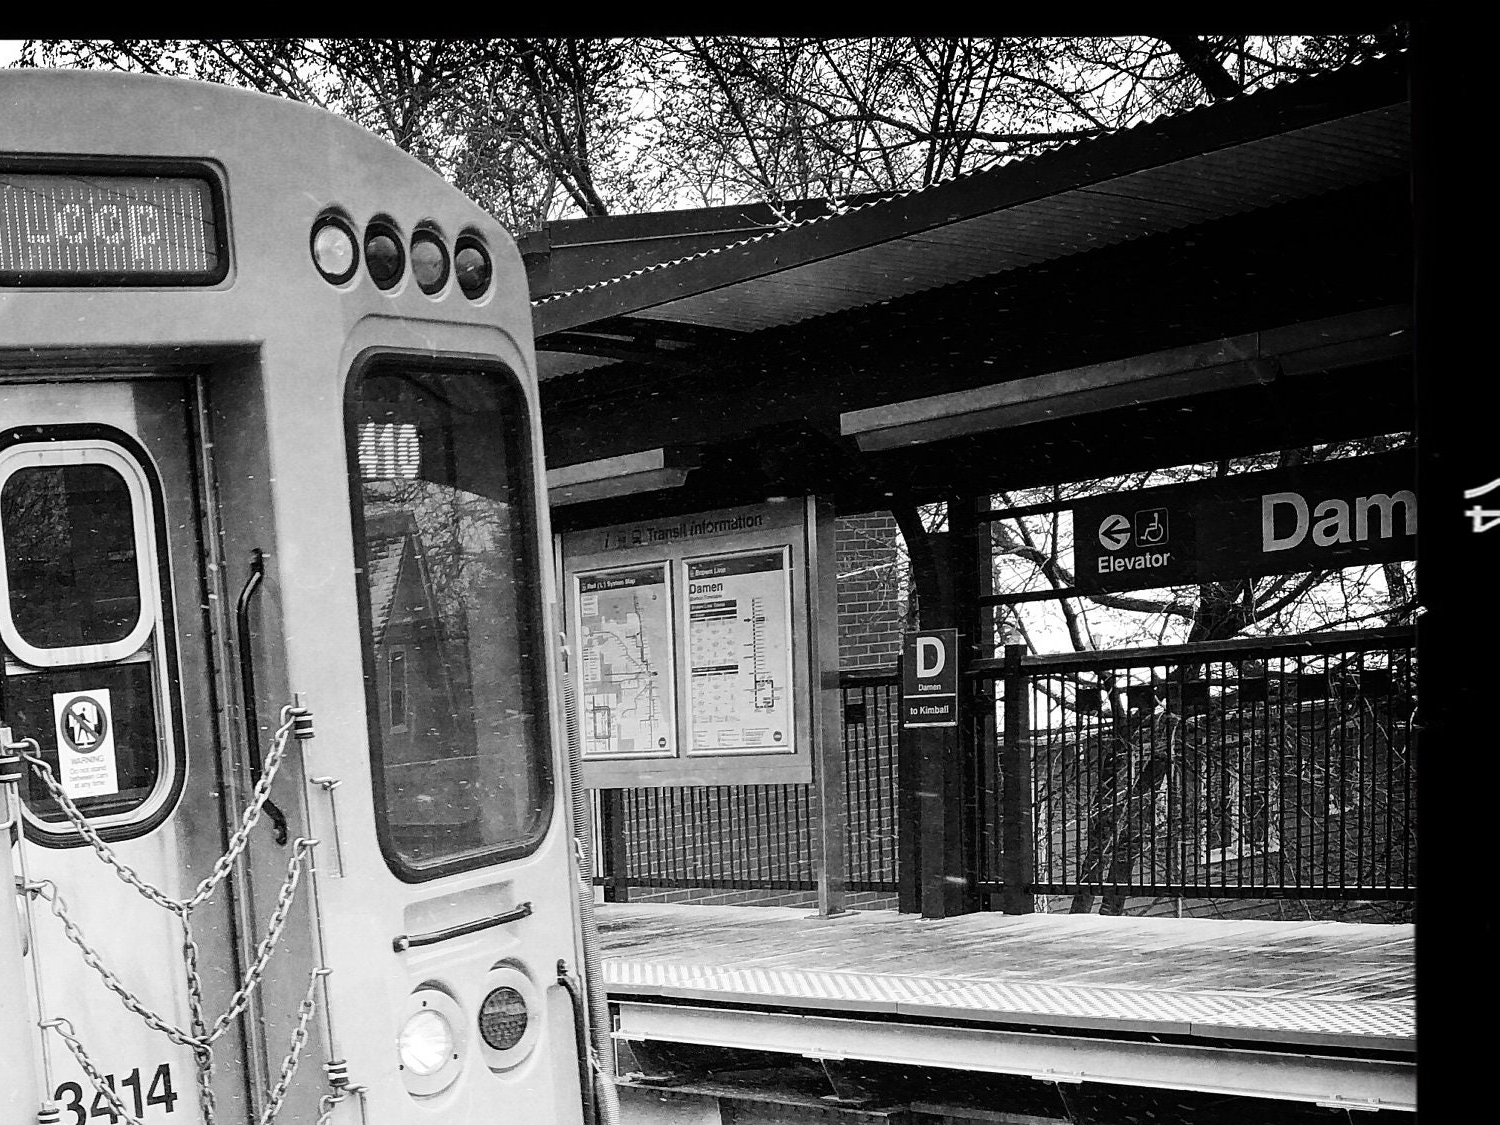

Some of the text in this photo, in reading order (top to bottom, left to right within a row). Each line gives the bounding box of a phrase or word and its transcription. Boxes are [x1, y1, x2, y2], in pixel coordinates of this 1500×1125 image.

[646, 514, 763, 542] Transit information
[1261, 489, 1419, 553] Dam
[1097, 551, 1171, 574] Elevator
[689, 583, 724, 595] Damen
[916, 636, 946, 678] D
[918, 683, 942, 692] Damen
[910, 705, 949, 715] to Kimball
